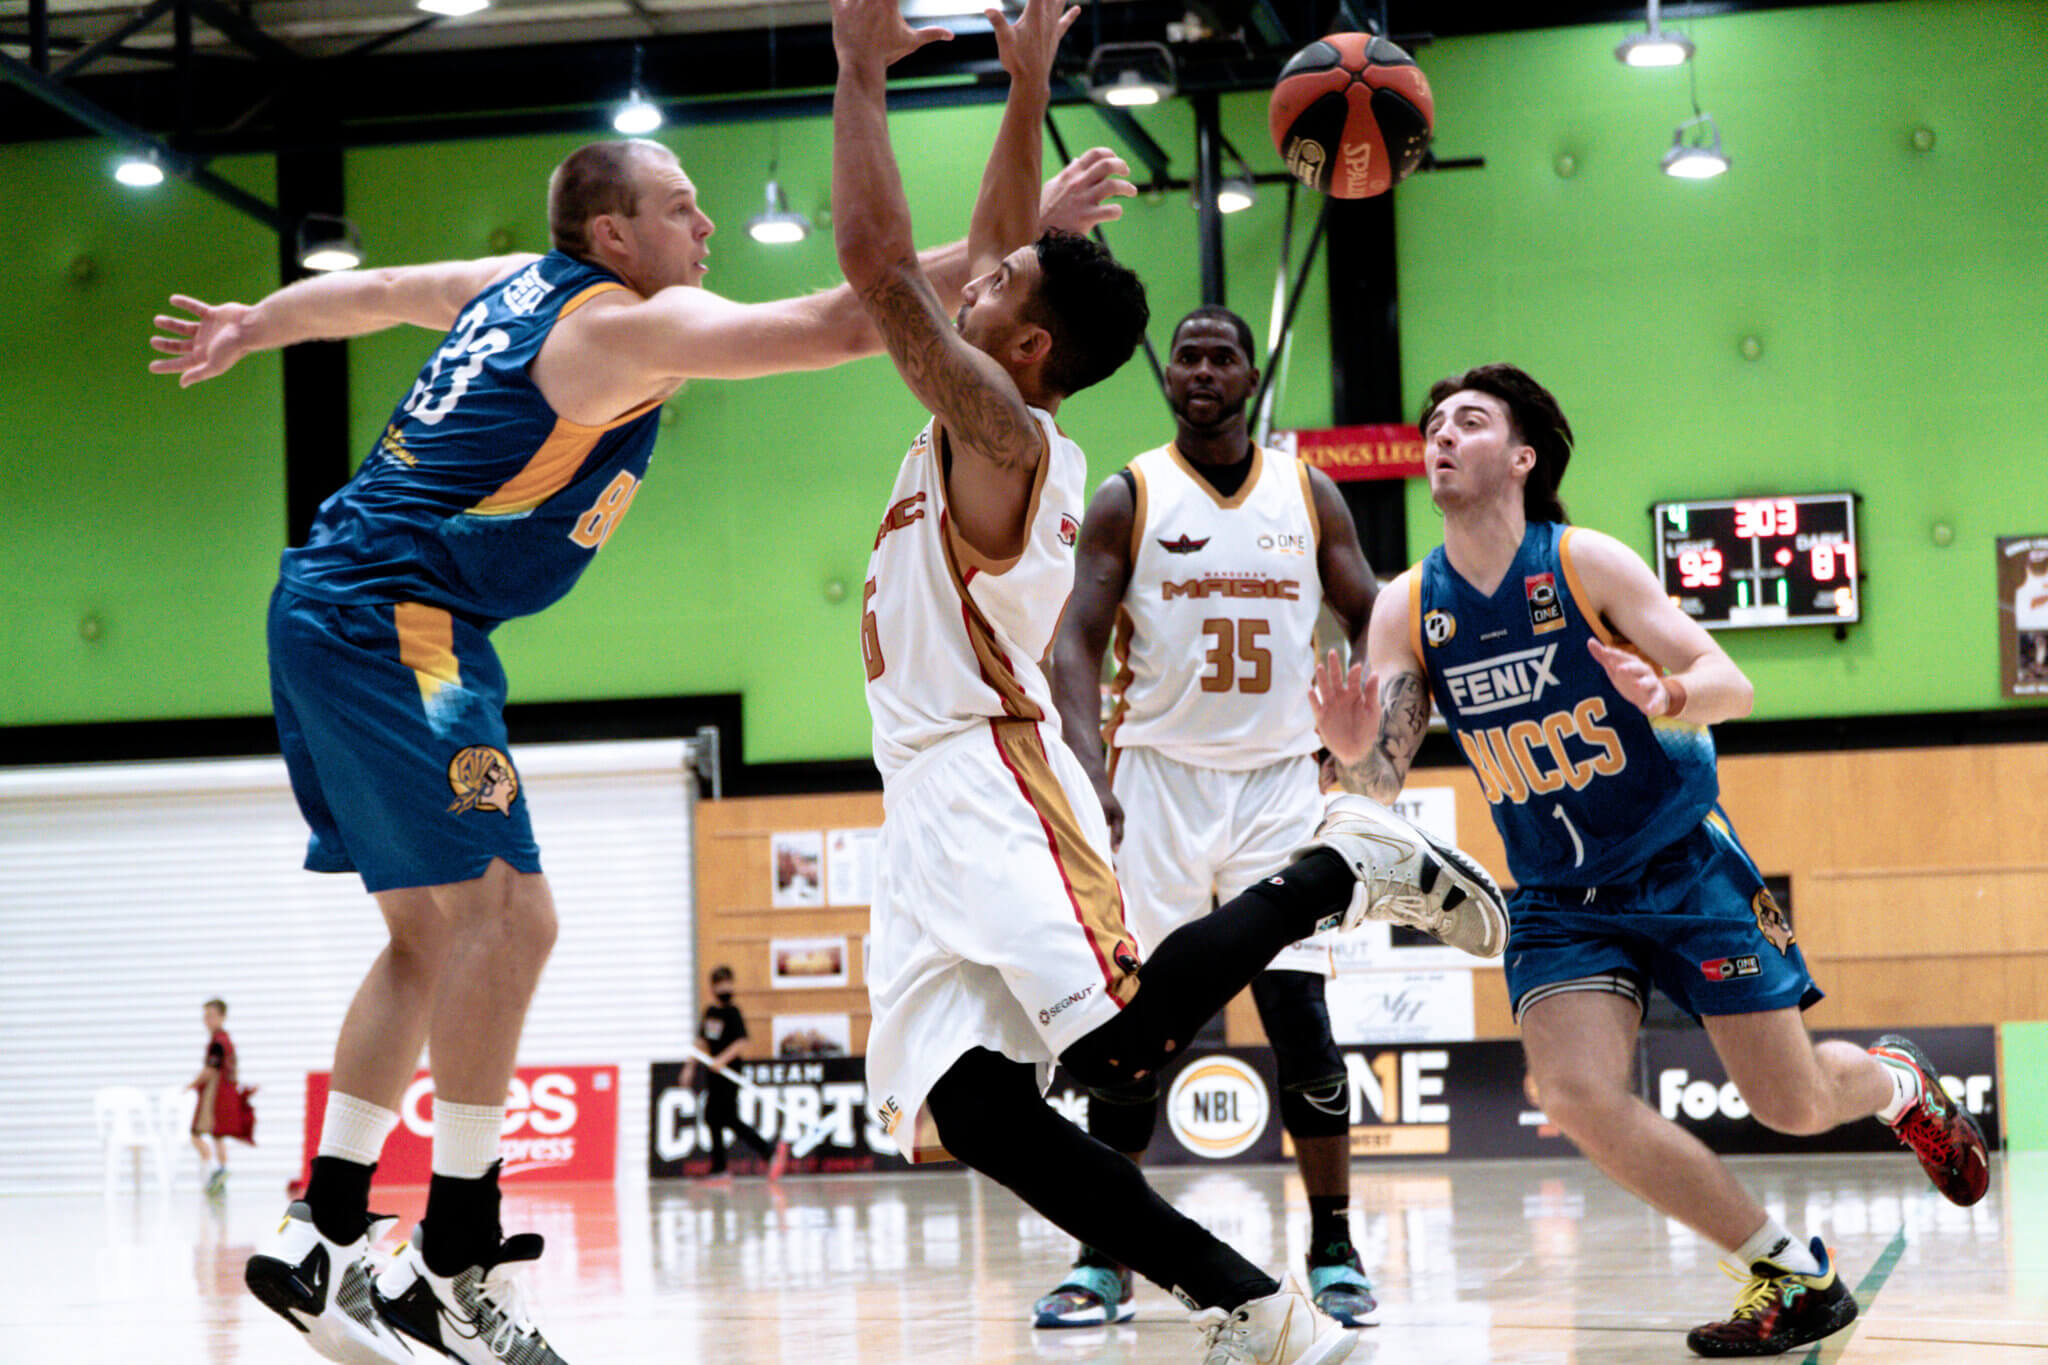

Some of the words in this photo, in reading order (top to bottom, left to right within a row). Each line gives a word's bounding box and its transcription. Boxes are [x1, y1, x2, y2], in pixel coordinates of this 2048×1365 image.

[1376, 441, 1426, 465] LEG
[1667, 504, 1688, 532] 4
[1679, 549, 1723, 587] 92
[1162, 579, 1300, 600] MAGIC
[1738, 580, 1748, 608] 1
[1777, 578, 1787, 607] 1
[1535, 604, 1559, 622] ONE
[1200, 618, 1272, 694] 35
[1447, 643, 1560, 708] FENIX
[1552, 803, 1585, 868] 1
[1193, 1091, 1242, 1124] NBL
[1659, 1069, 1752, 1120] Foo
